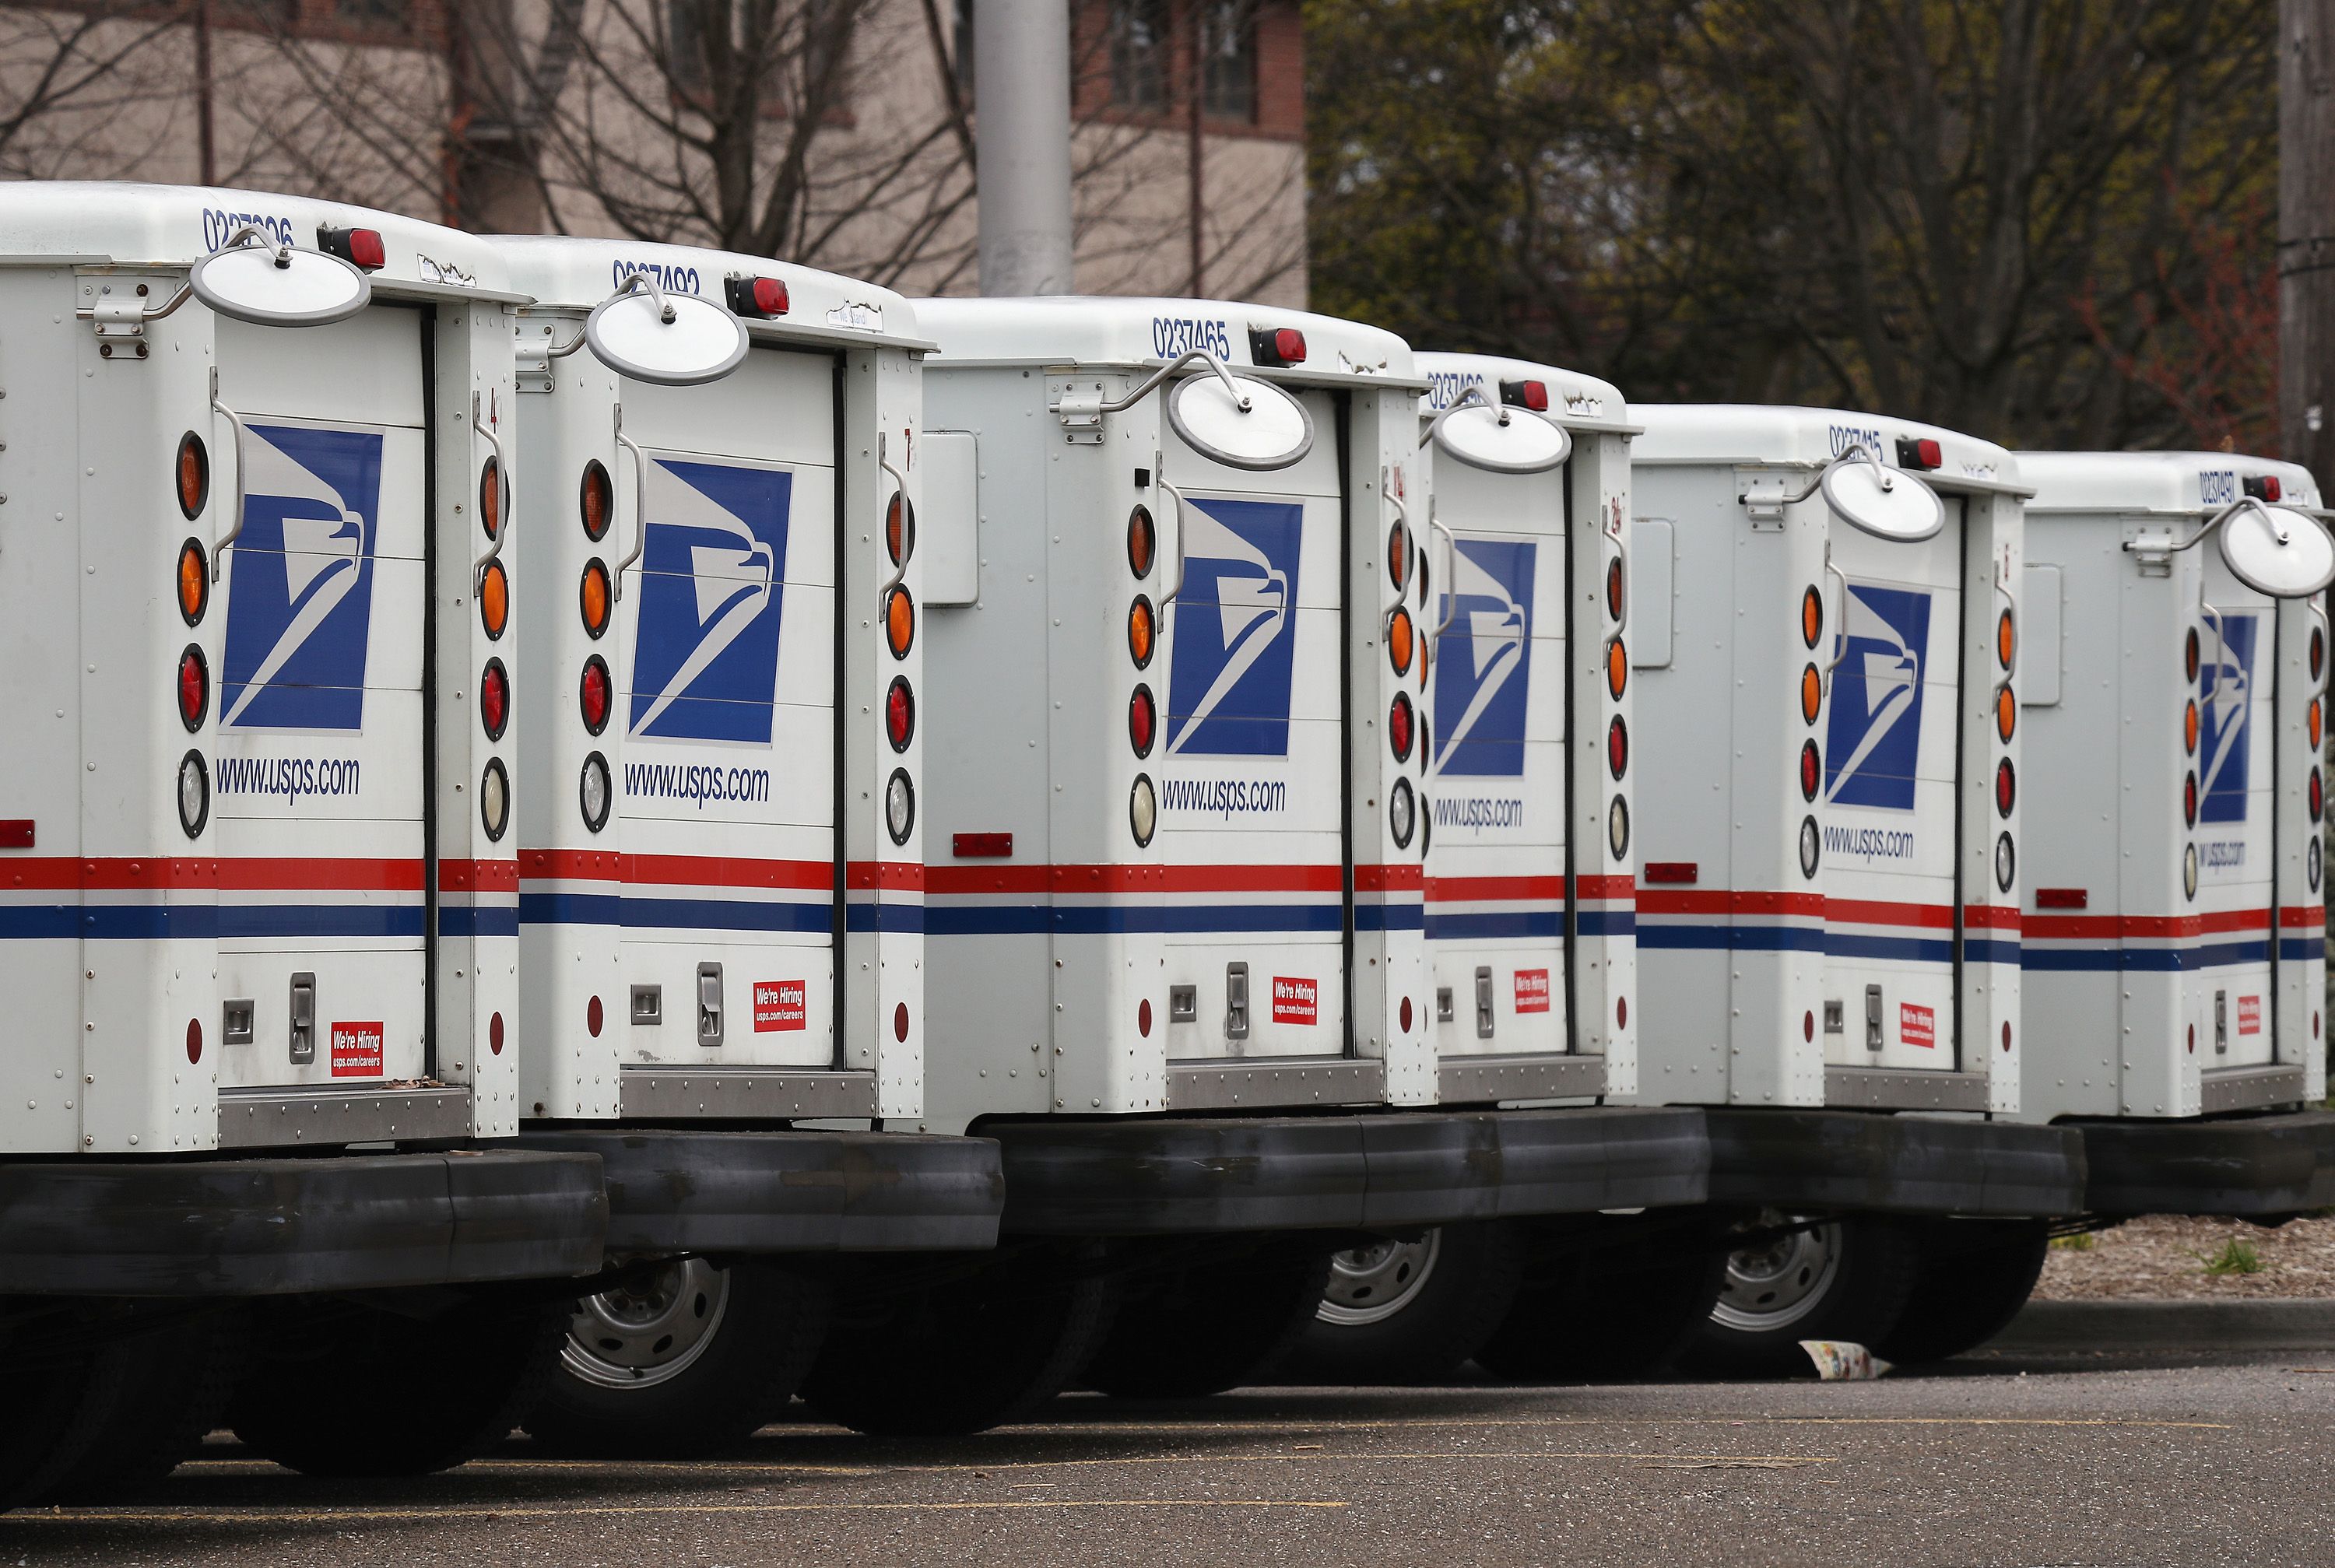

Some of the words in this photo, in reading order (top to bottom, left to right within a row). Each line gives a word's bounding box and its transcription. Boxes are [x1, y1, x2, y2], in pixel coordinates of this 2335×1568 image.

[1153, 317, 1230, 362] 0237465
[2200, 471, 2235, 504] 0237497
[216, 758, 360, 806] www.usps.com
[624, 763, 770, 810] www.usps.com
[1162, 780, 1286, 821] www.usps.com
[757, 987, 778, 1005] We're
[779, 986, 803, 1007] Hiring
[1275, 981, 1294, 999] We're
[1294, 983, 1315, 1005] Hiring
[756, 1009, 803, 1023] usps.com/careers
[1274, 1003, 1315, 1016] usps.com/careers
[333, 1030, 356, 1050] We're
[356, 1030, 381, 1053] Hiring
[333, 1054, 381, 1070] usps.com/careers
